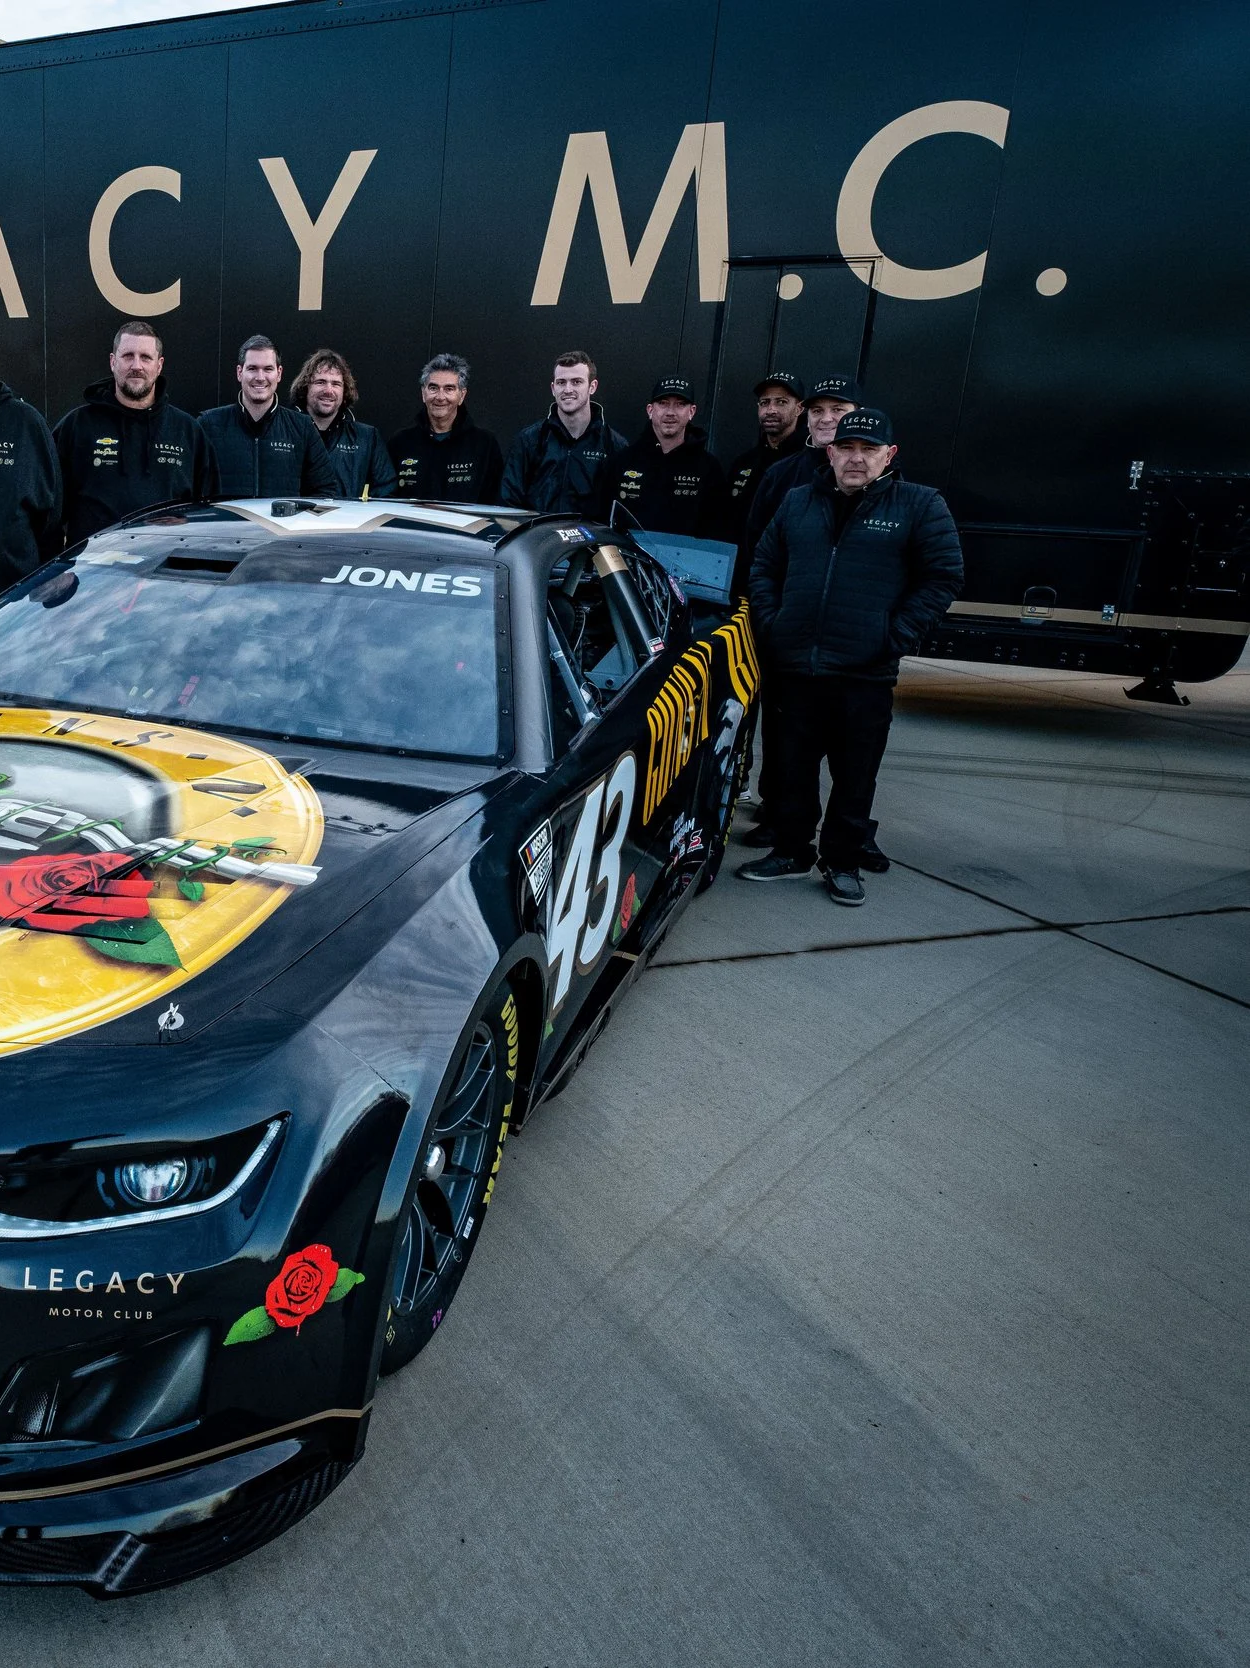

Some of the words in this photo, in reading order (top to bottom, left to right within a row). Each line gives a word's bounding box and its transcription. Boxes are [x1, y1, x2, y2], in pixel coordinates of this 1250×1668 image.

[530, 99, 1068, 306] M.C.
[661, 378, 689, 387] LEGACY
[814, 379, 847, 390] LEGACY
[843, 416, 881, 426] LEGACY
[155, 443, 184, 452] LEGACY
[863, 519, 900, 528] LEGACY
[320, 565, 482, 597] JONES
[549, 753, 636, 1011] 43
[24, 1266, 185, 1294] LEGACY
[48, 1307, 103, 1319] MOTOR
[113, 1310, 153, 1320] CLUB
